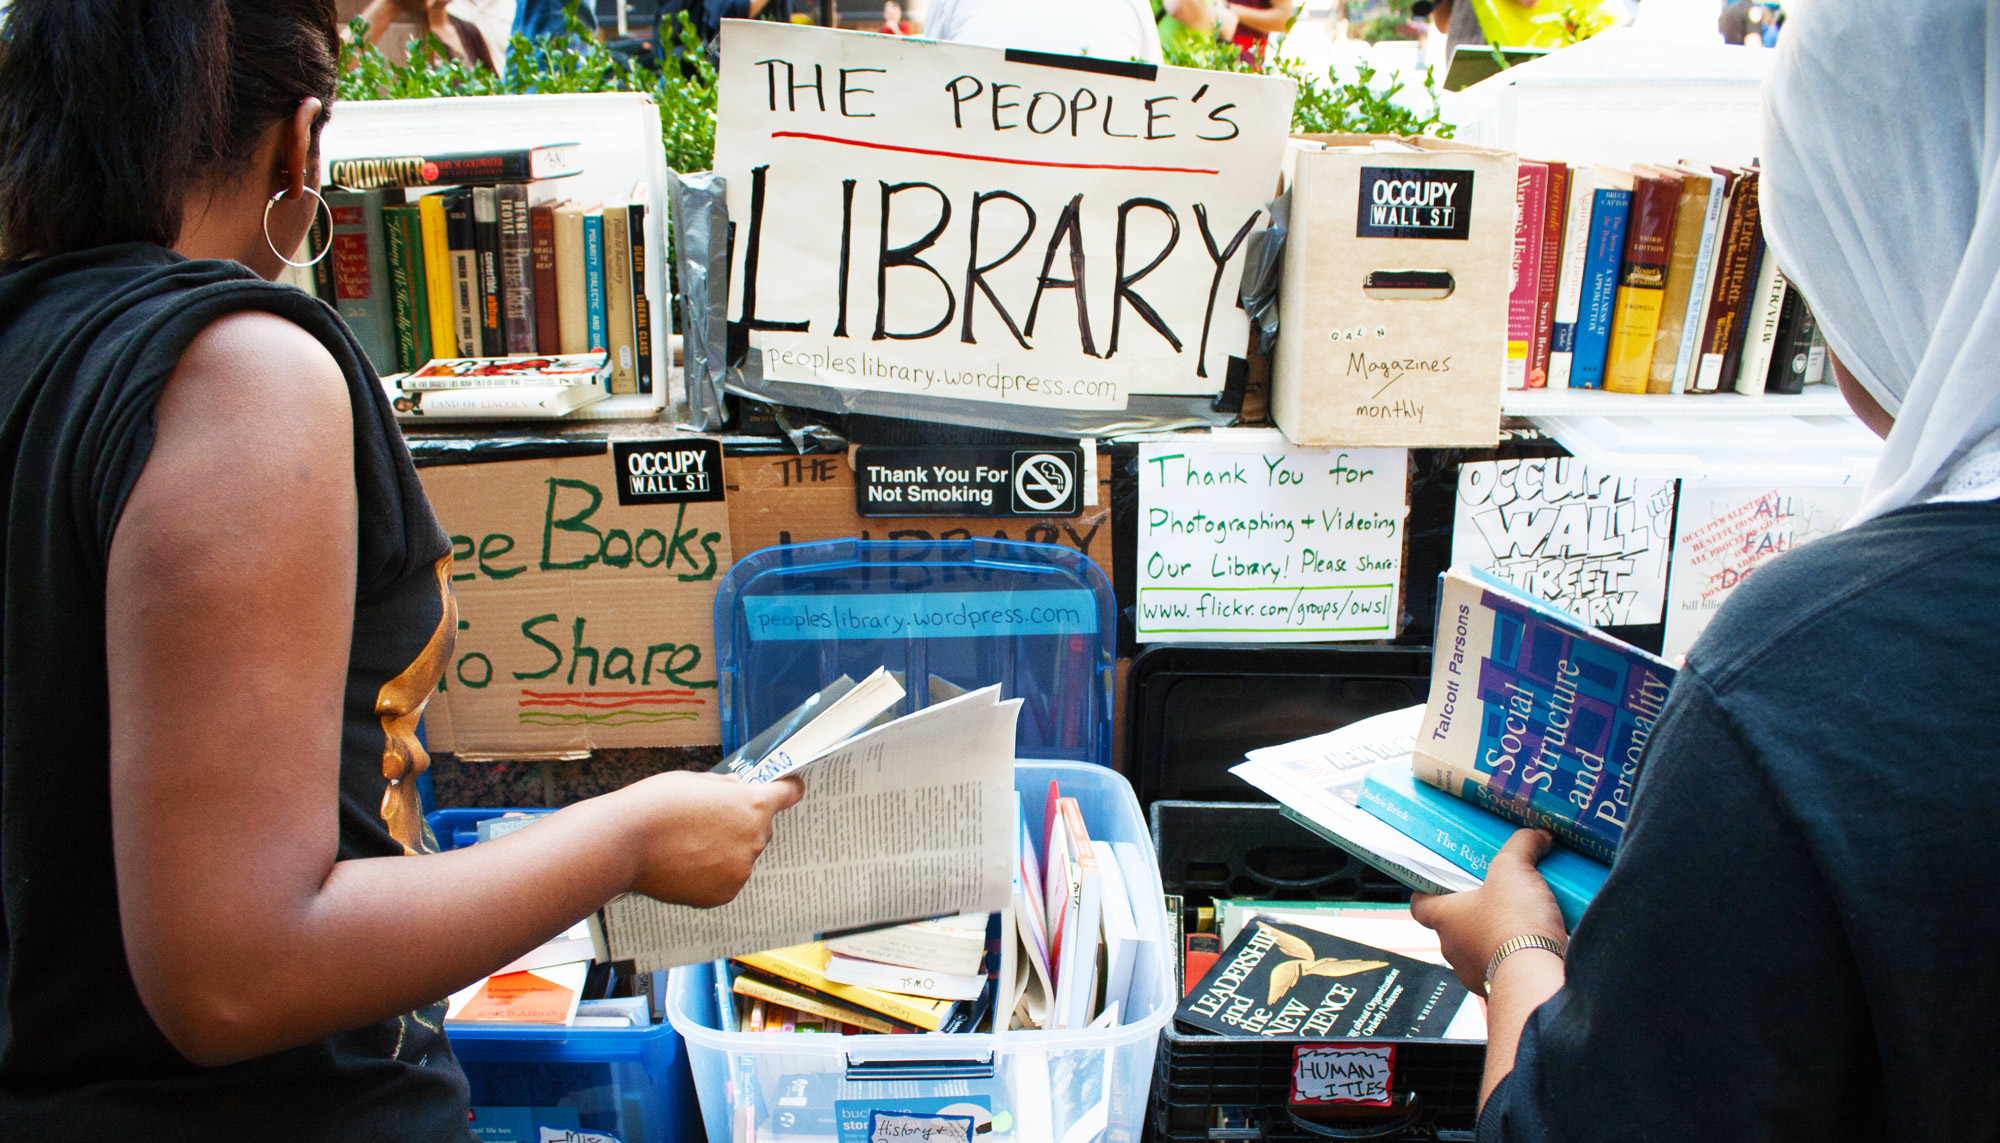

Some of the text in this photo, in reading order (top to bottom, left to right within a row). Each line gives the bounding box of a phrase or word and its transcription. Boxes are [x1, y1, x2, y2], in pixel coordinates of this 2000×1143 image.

[755, 60, 1240, 142] THE PEOPLE'S
[333, 157, 429, 189] GOLDWATER
[1372, 179, 1459, 207] OCCUPY
[1514, 174, 1531, 236] Women's
[1550, 173, 1564, 231] Fortytude
[514, 201, 528, 234] HENRI
[1373, 206, 1453, 227] WALL ST
[1578, 191, 1593, 233] Against
[1640, 235, 1662, 243] THIRD
[1699, 233, 1714, 261] Health
[1738, 208, 1758, 252] WERE
[633, 245, 645, 272] DEATH
[1634, 243, 1665, 253] EDITION
[740, 164, 1262, 379] LIBRARY
[1569, 255, 1585, 308] Enemies
[1697, 262, 1709, 280] Care
[1727, 256, 1750, 306] THERE
[485, 251, 498, 328] convertible arbitrage
[1588, 272, 1604, 332] APPOMATTOX
[1597, 267, 1614, 336] A STILLNESS AT
[1691, 299, 1702, 314] Not
[1694, 282, 1706, 297] Will
[1762, 264, 1785, 346] TER/VIEW
[592, 315, 600, 330] AND
[636, 294, 648, 328] LIBERAL
[1538, 302, 1550, 333] Sarah
[638, 330, 649, 356] CLASS
[1535, 337, 1547, 367] Broka
[766, 346, 1118, 402] peopleslibrary.wordpress.com
[1346, 352, 1453, 380] Magazines
[431, 399, 528, 409] LAND OF LINCOLN
[1356, 399, 1425, 424] monthly
[628, 450, 707, 476] OCCUPY
[772, 458, 839, 487] THE
[867, 466, 1009, 483] Thank You For
[1148, 453, 1375, 488] Thank You for
[631, 473, 708, 493] WALL ST
[868, 485, 993, 506] Not Smoking
[1753, 496, 1795, 518] ALL
[453, 477, 722, 582] ee Books
[1148, 507, 1397, 543] Photographing + Videoing
[1471, 502, 1650, 560] WALL
[1744, 531, 1793, 553] FALL
[1147, 551, 1192, 579] Our
[1211, 552, 1290, 584] Library!
[1301, 548, 1348, 573] Please
[757, 601, 1081, 634] peopleslibrary.wordpress.com
[512, 613, 719, 690] Share
[1432, 603, 1471, 742] Talcott Parsons
[1485, 681, 1536, 776] Social
[1521, 658, 1581, 792] Structure
[1594, 669, 1671, 831] Personality
[1567, 751, 1606, 811] and
[1387, 801, 1410, 822] Brink
[1436, 828, 1458, 852] The
[1477, 784, 1616, 860] Social Structur
[1383, 859, 1432, 890] WOMEN'S
[1188, 926, 1280, 1019] LEADERSHIP
[880, 1000, 911, 1021] Legacy
[1219, 992, 1254, 1027] and
[1299, 982, 1359, 1039] CIENCE
[1353, 966, 1401, 1031] about Organization
[1362, 983, 1405, 1037] Orderly Universe
[1416, 979, 1448, 1021] WHEATLEY
[1241, 1006, 1274, 1035] the
[1260, 996, 1312, 1038] NEW
[1299, 1060, 1388, 1081] HUMAN-
[1323, 1079, 1387, 1098] ITIES
[878, 1119, 933, 1141] History
